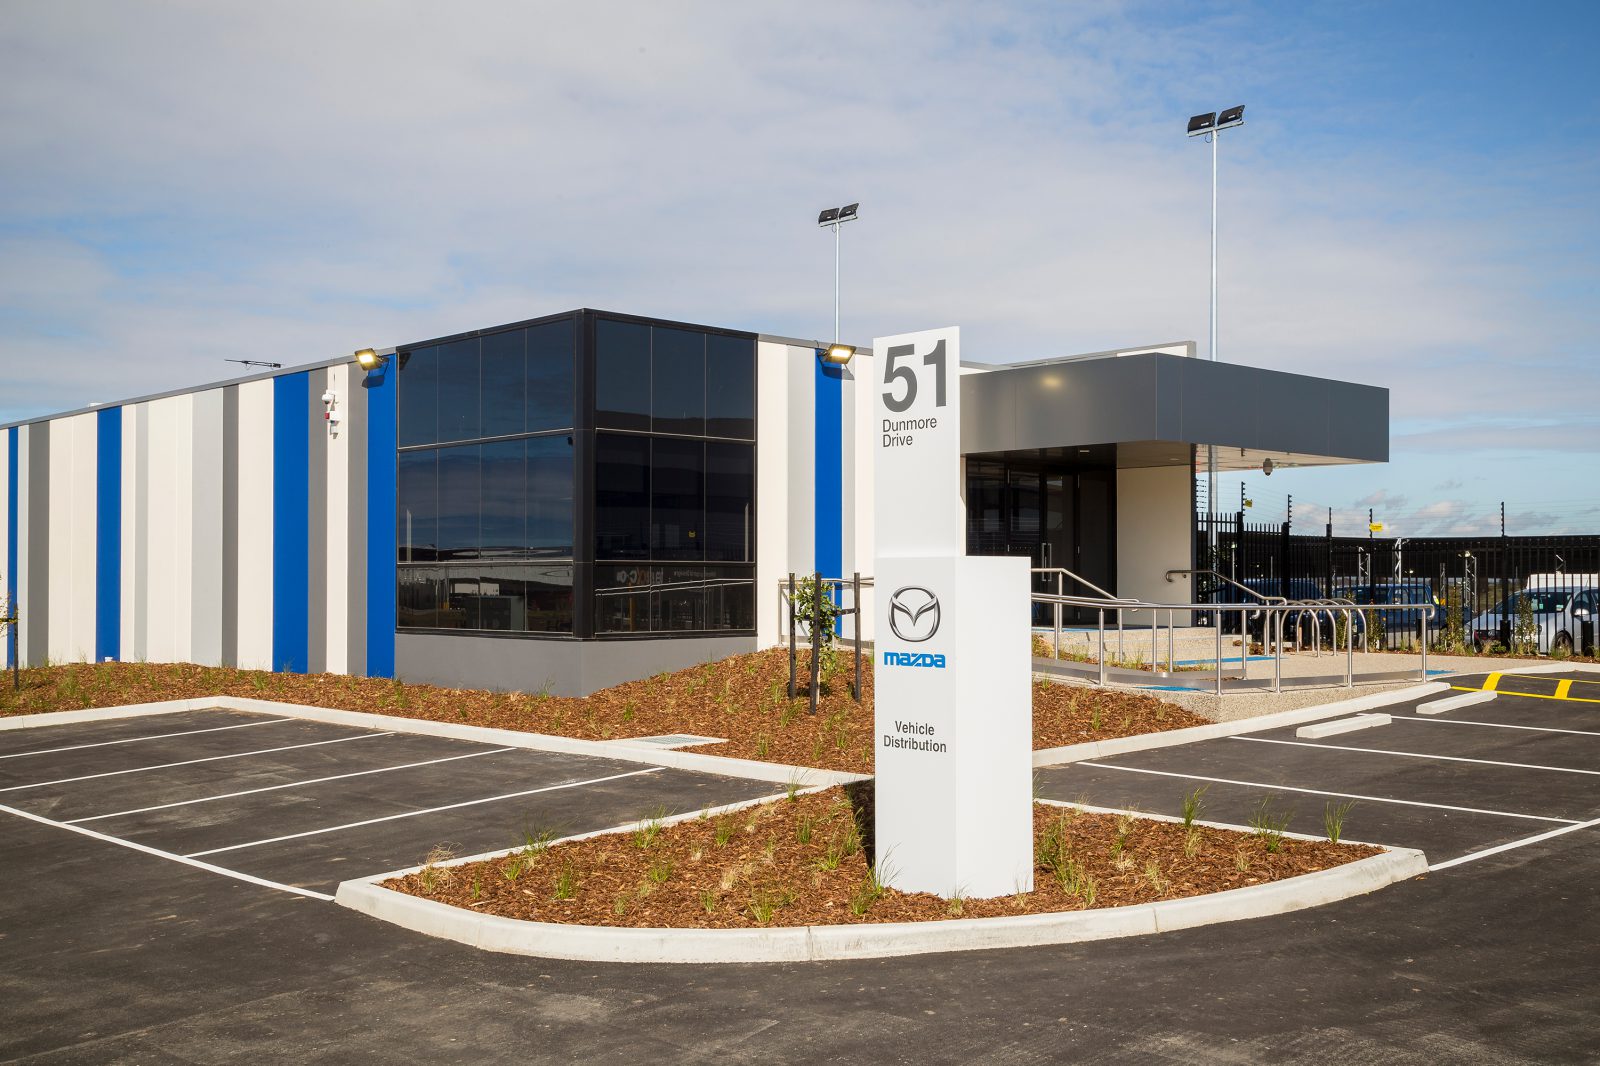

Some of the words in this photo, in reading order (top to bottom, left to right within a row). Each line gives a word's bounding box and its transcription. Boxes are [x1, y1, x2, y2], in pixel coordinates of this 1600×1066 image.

[882, 338, 947, 413] 51
[882, 417, 938, 433] Dunmore
[882, 433, 913, 448] Drive
[894, 720, 935, 736] Vehicle
[883, 734, 947, 753] Distribution
